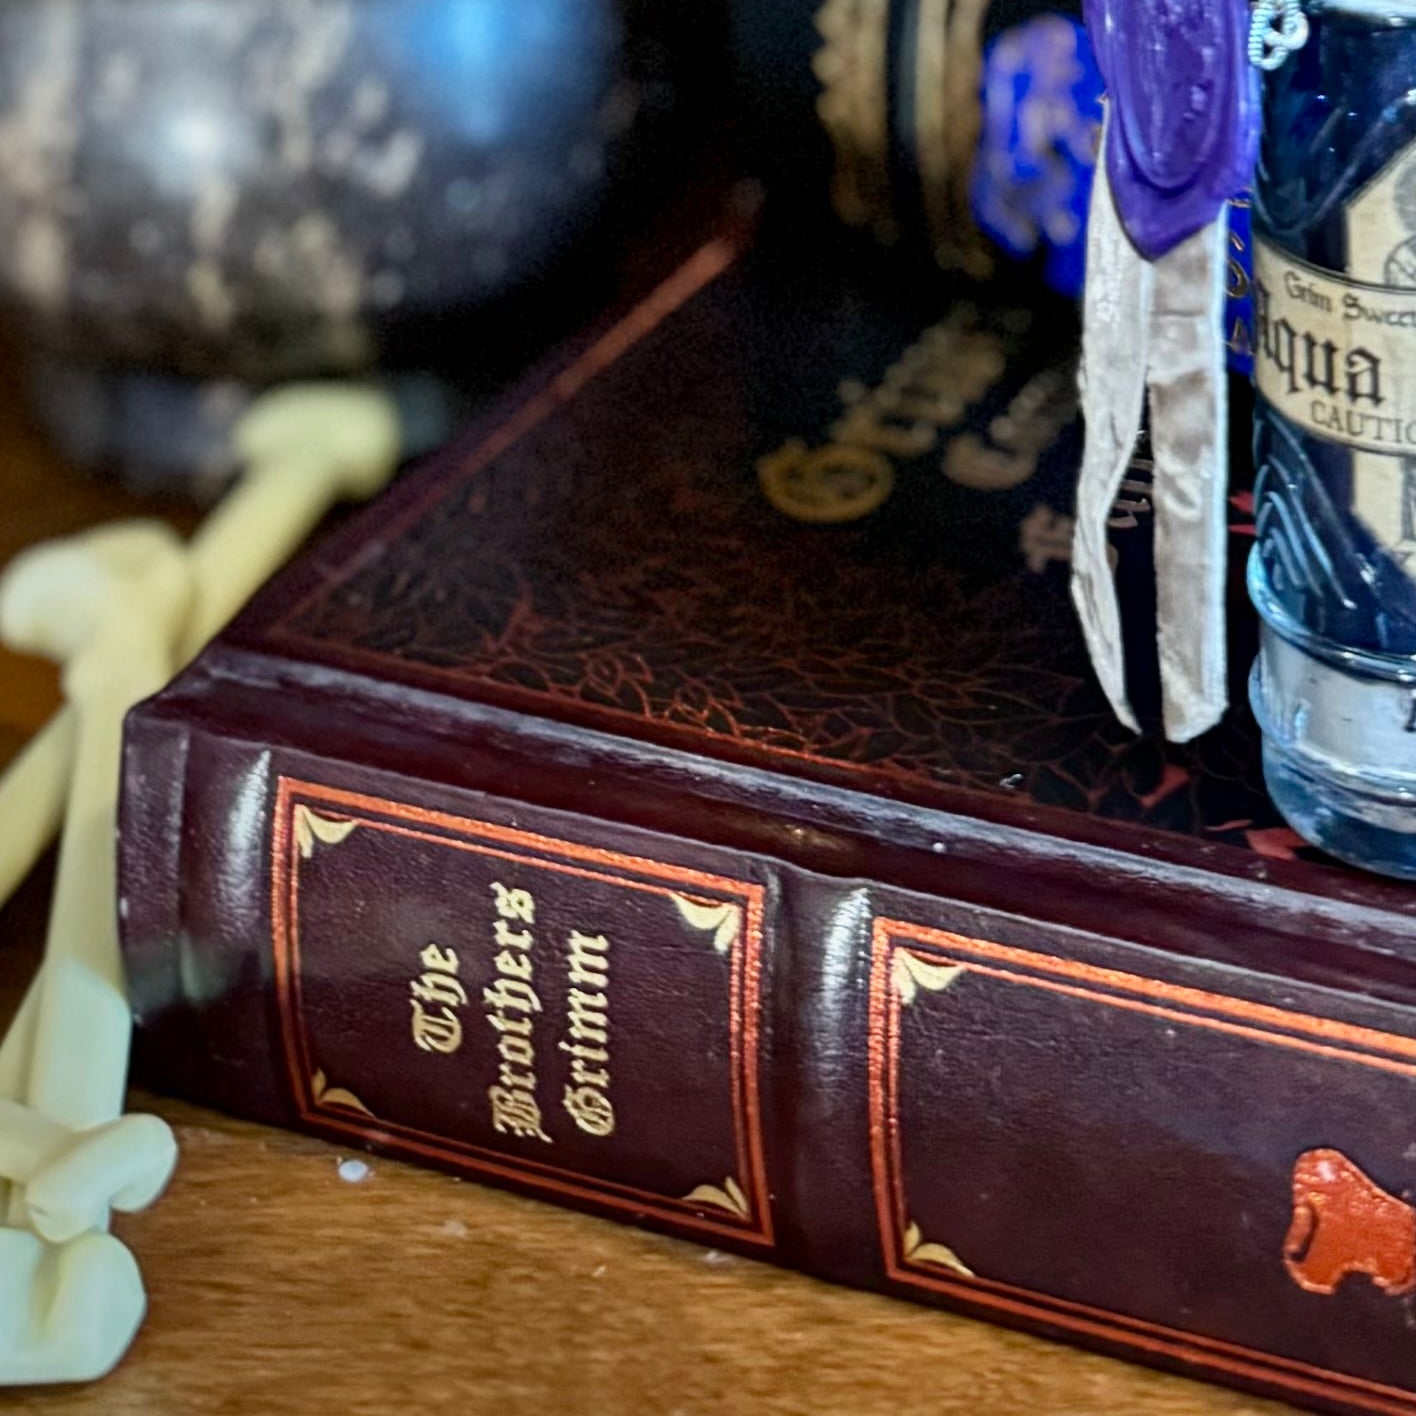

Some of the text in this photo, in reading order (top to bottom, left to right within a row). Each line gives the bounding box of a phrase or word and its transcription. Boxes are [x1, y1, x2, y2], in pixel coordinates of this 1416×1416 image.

[1284, 271, 1334, 313] Grim
[410, 943, 469, 1055] The
[484, 881, 554, 1143] Brothers
[558, 930, 615, 1136] Grimm
